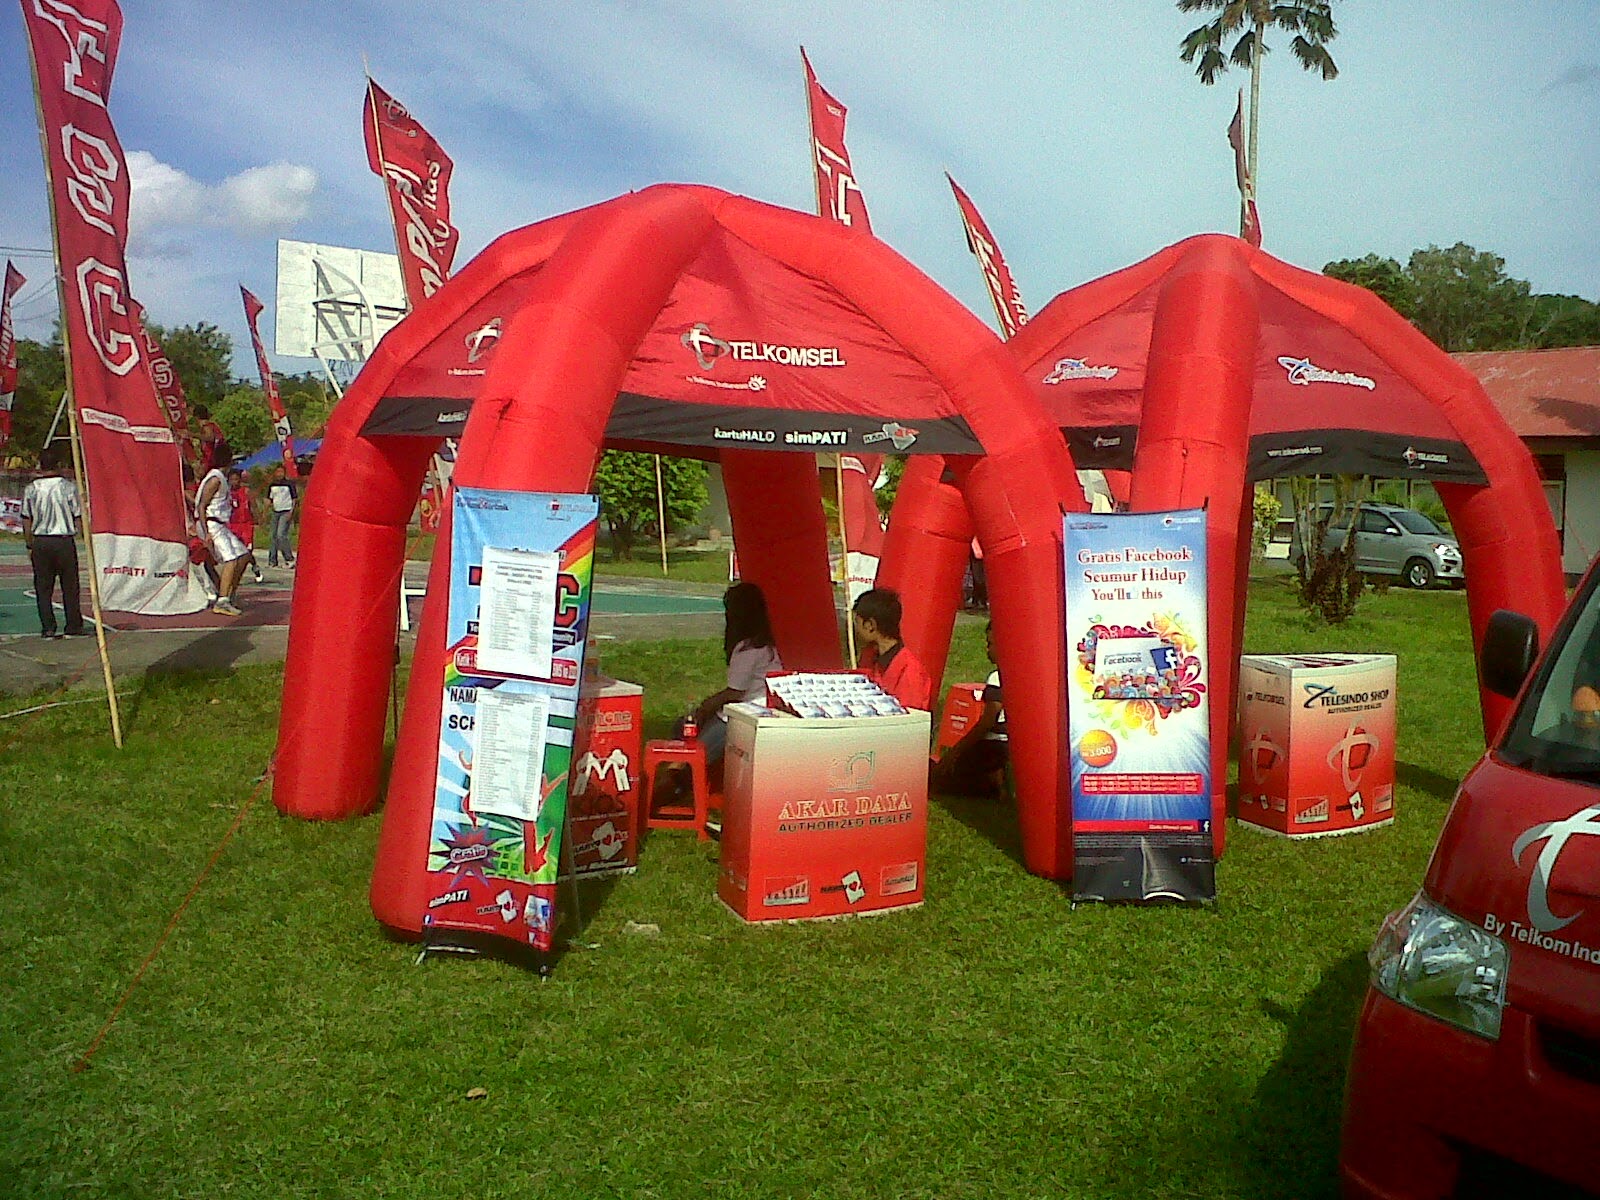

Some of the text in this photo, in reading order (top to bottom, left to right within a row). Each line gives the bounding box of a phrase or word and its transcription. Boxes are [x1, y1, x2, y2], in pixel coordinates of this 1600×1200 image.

[729, 341, 845, 367] TELKOMSEL
[714, 427, 775, 442] kartuHALO
[785, 430, 847, 445] simPATI
[1078, 547, 1192, 564] Gratis Facebook
[1084, 567, 1187, 584] Seumur Hidup
[1092, 587, 1163, 601] You'll this
[1103, 654, 1142, 665] Facebook
[450, 687, 477, 704] NAM
[1321, 689, 1389, 707] TELESINDO SHOP
[778, 792, 913, 820] AKAR DAYA
[778, 812, 913, 833] AUTHORIZED DEALER
[1484, 913, 1506, 936] By
[1510, 921, 1570, 956] Telkom
